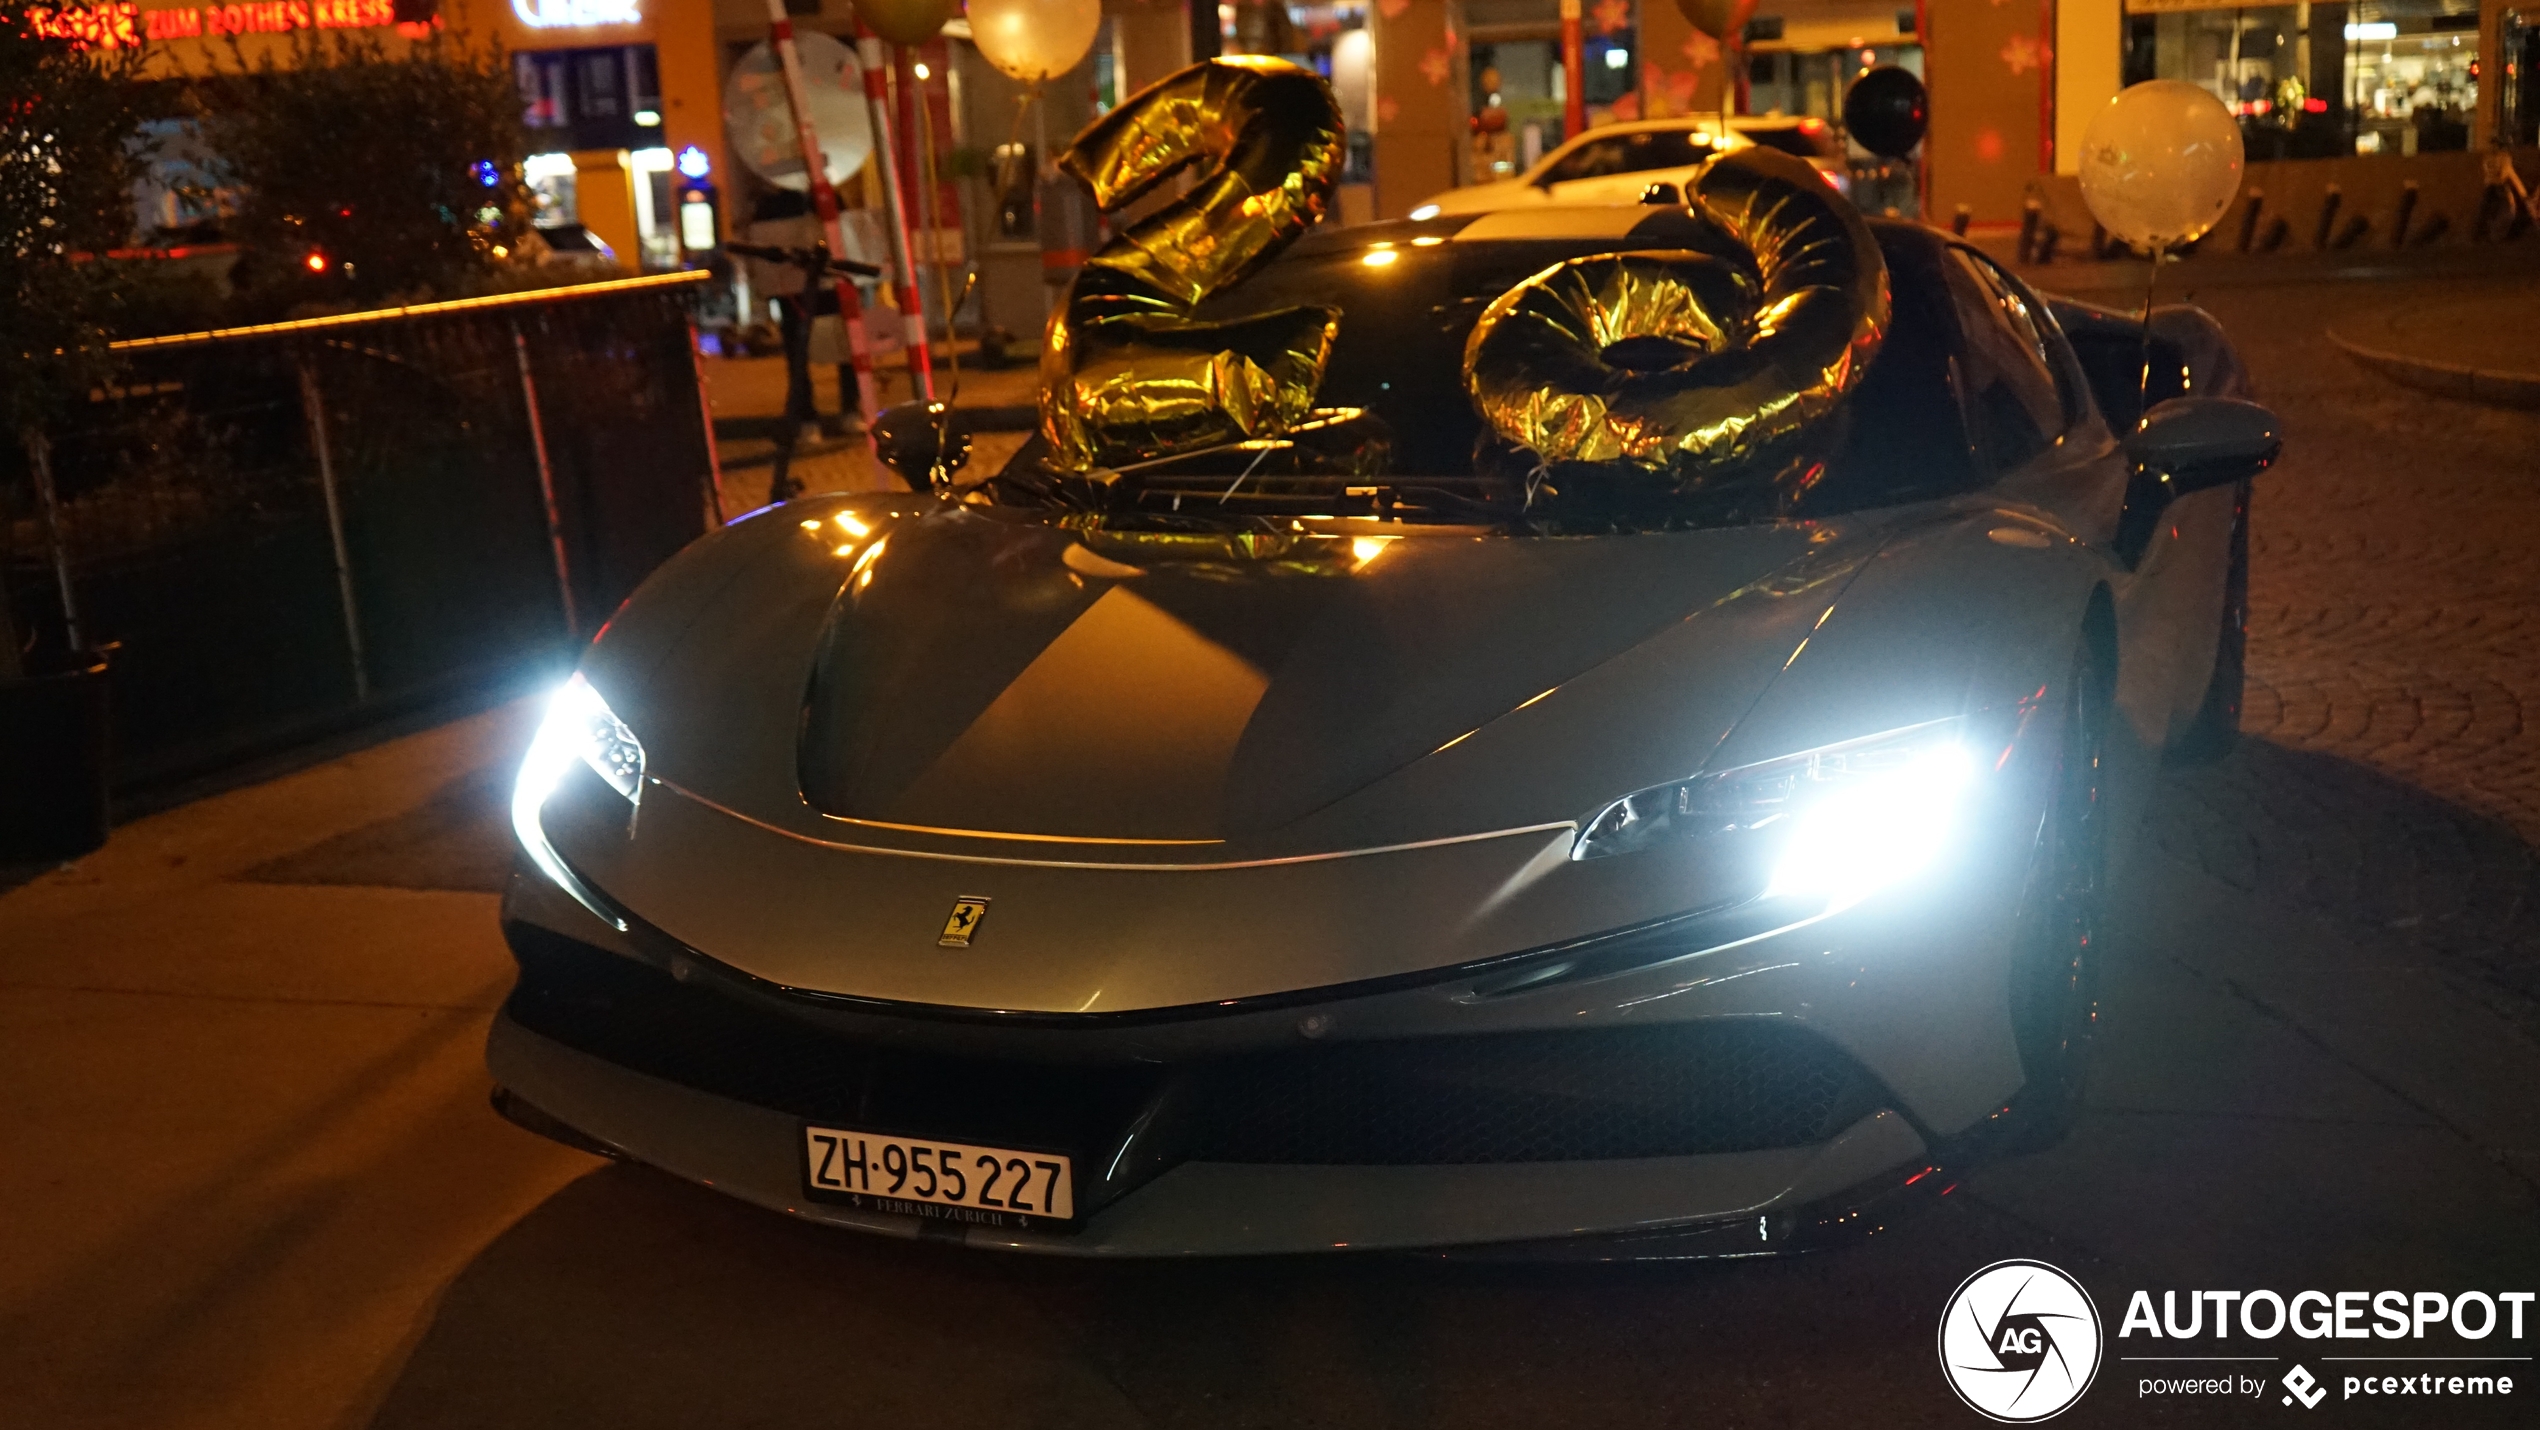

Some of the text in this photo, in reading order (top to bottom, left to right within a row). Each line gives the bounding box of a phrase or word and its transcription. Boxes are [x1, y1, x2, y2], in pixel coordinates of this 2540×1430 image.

[145, 8, 202, 39] ZUM
[876, 1198, 1003, 1226] FERRARI ZÜRICH
